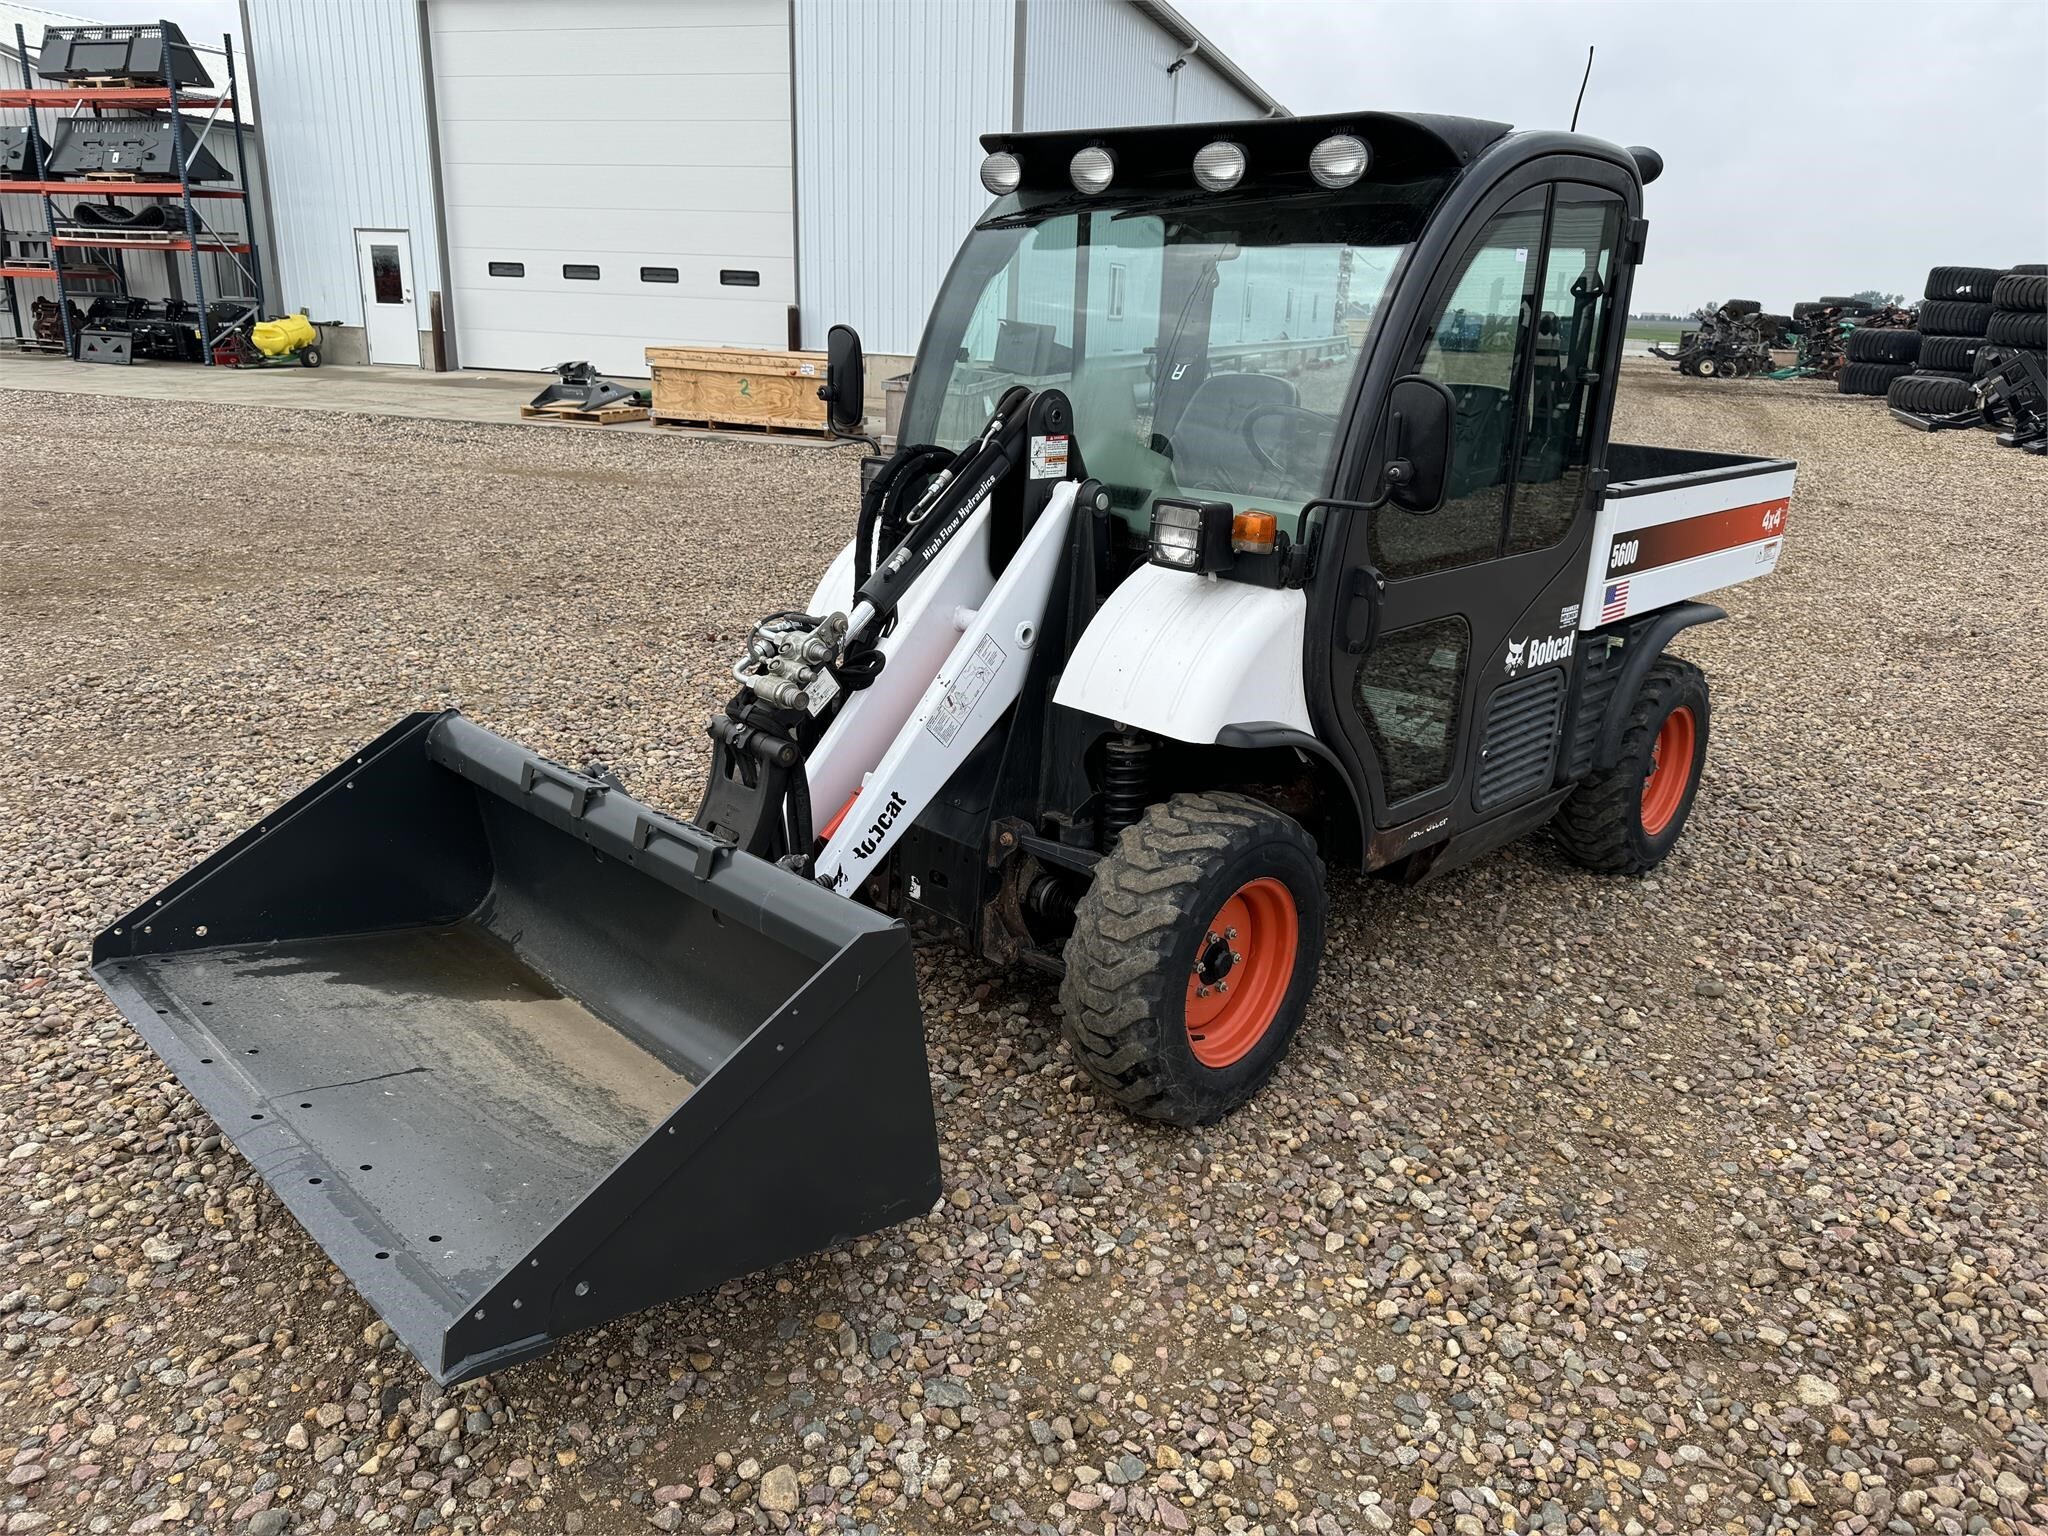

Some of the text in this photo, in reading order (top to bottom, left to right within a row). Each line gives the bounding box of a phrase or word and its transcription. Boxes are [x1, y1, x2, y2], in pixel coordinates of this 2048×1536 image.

[922, 475, 996, 560] High Flow Hydraulics
[1761, 507, 1781, 530] 4x4
[1610, 539, 1639, 569] 5600
[1527, 629, 1575, 669] Bobcat
